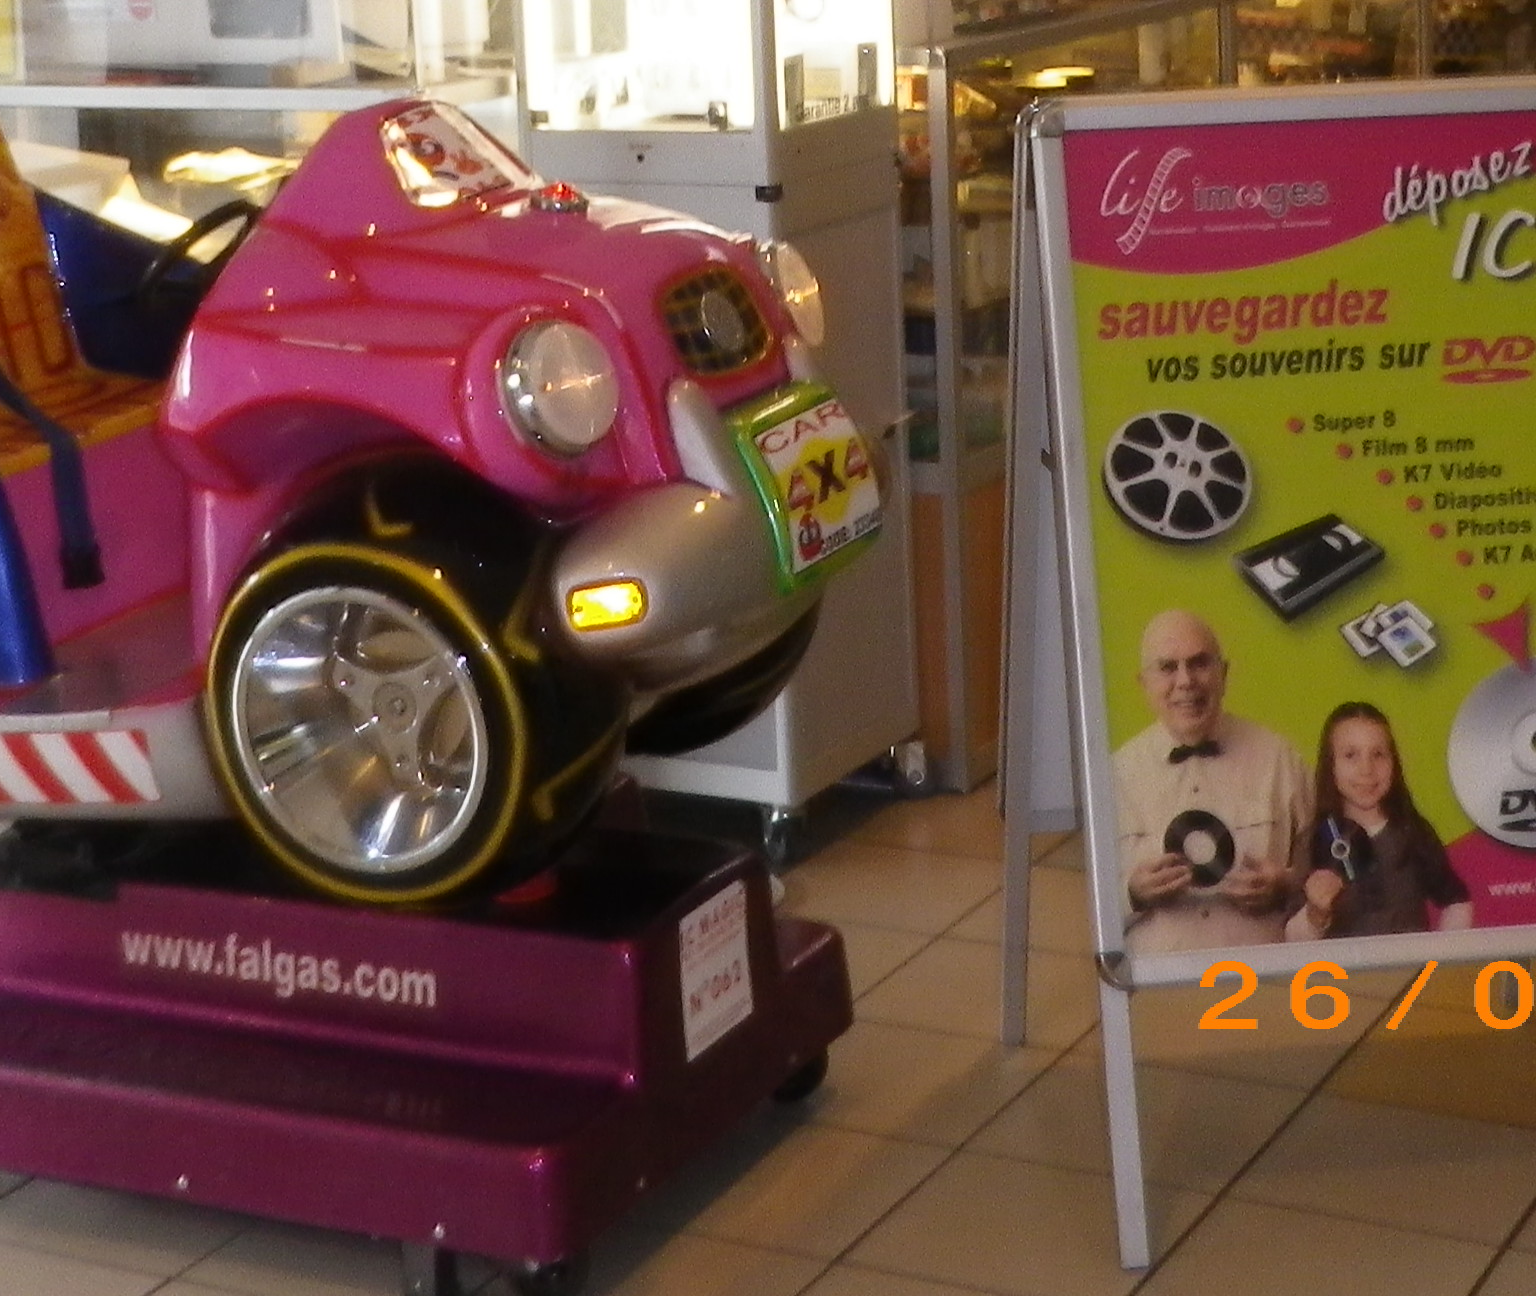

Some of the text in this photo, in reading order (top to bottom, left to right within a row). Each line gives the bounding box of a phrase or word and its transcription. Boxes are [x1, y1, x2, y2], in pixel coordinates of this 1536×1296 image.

[1192, 176, 1331, 219] images
[1381, 140, 1533, 226] déposez
[1097, 279, 1389, 345] sauvegardez
[1147, 352, 1200, 383] vos
[1210, 338, 1365, 381] souvenirs
[1379, 338, 1432, 369] sur
[760, 403, 846, 454] CAR
[1312, 410, 1397, 435] Super 8
[1361, 437, 1409, 458] Film
[1435, 439, 1475, 454] mm
[1402, 460, 1503, 485] K7 Vidéo
[1456, 516, 1532, 538] Photos
[1482, 544, 1514, 566] K7
[120, 929, 438, 1007] www.falgas.com
